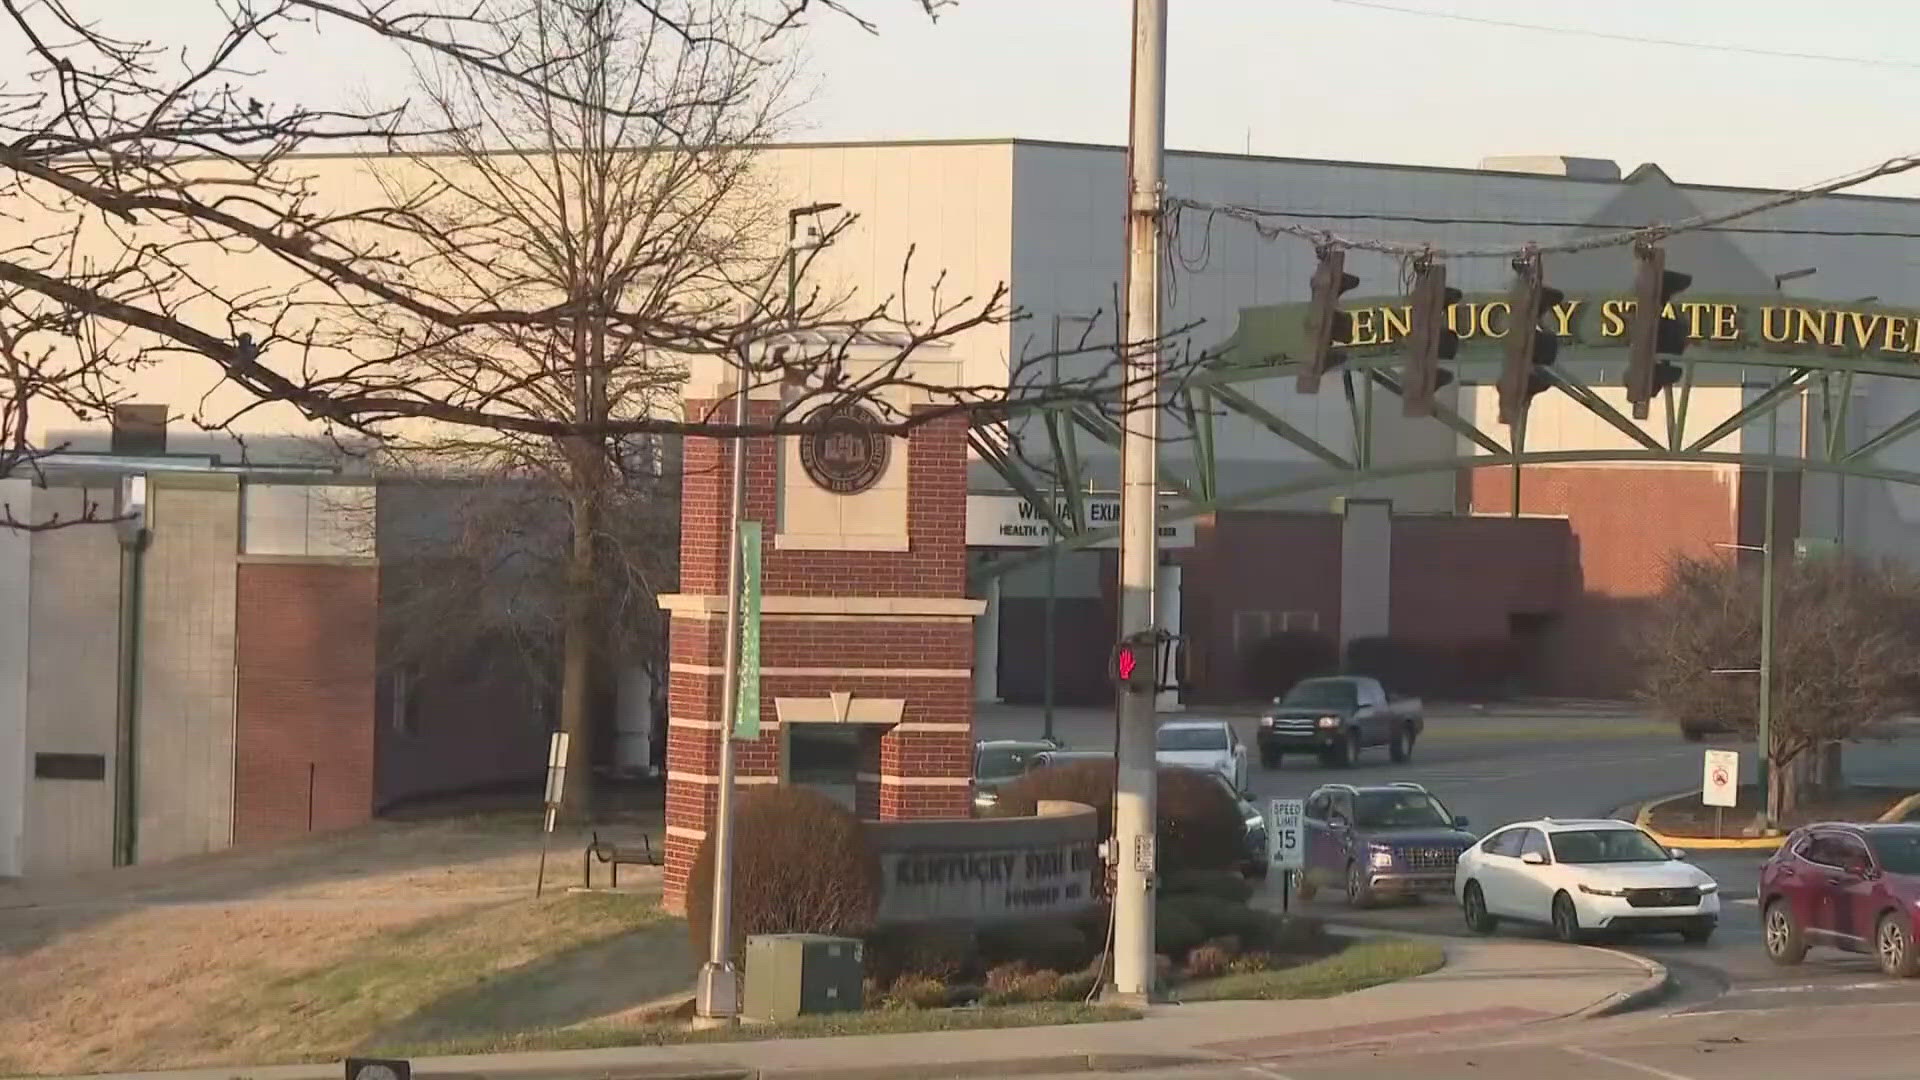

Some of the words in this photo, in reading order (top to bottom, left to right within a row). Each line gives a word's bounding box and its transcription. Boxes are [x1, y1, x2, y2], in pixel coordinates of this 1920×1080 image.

[1330, 300, 1582, 348] ENUCY
[1274, 803, 1301, 815] SPEED
[1277, 815, 1297, 828] LIMIT
[1278, 829, 1297, 849] 15
